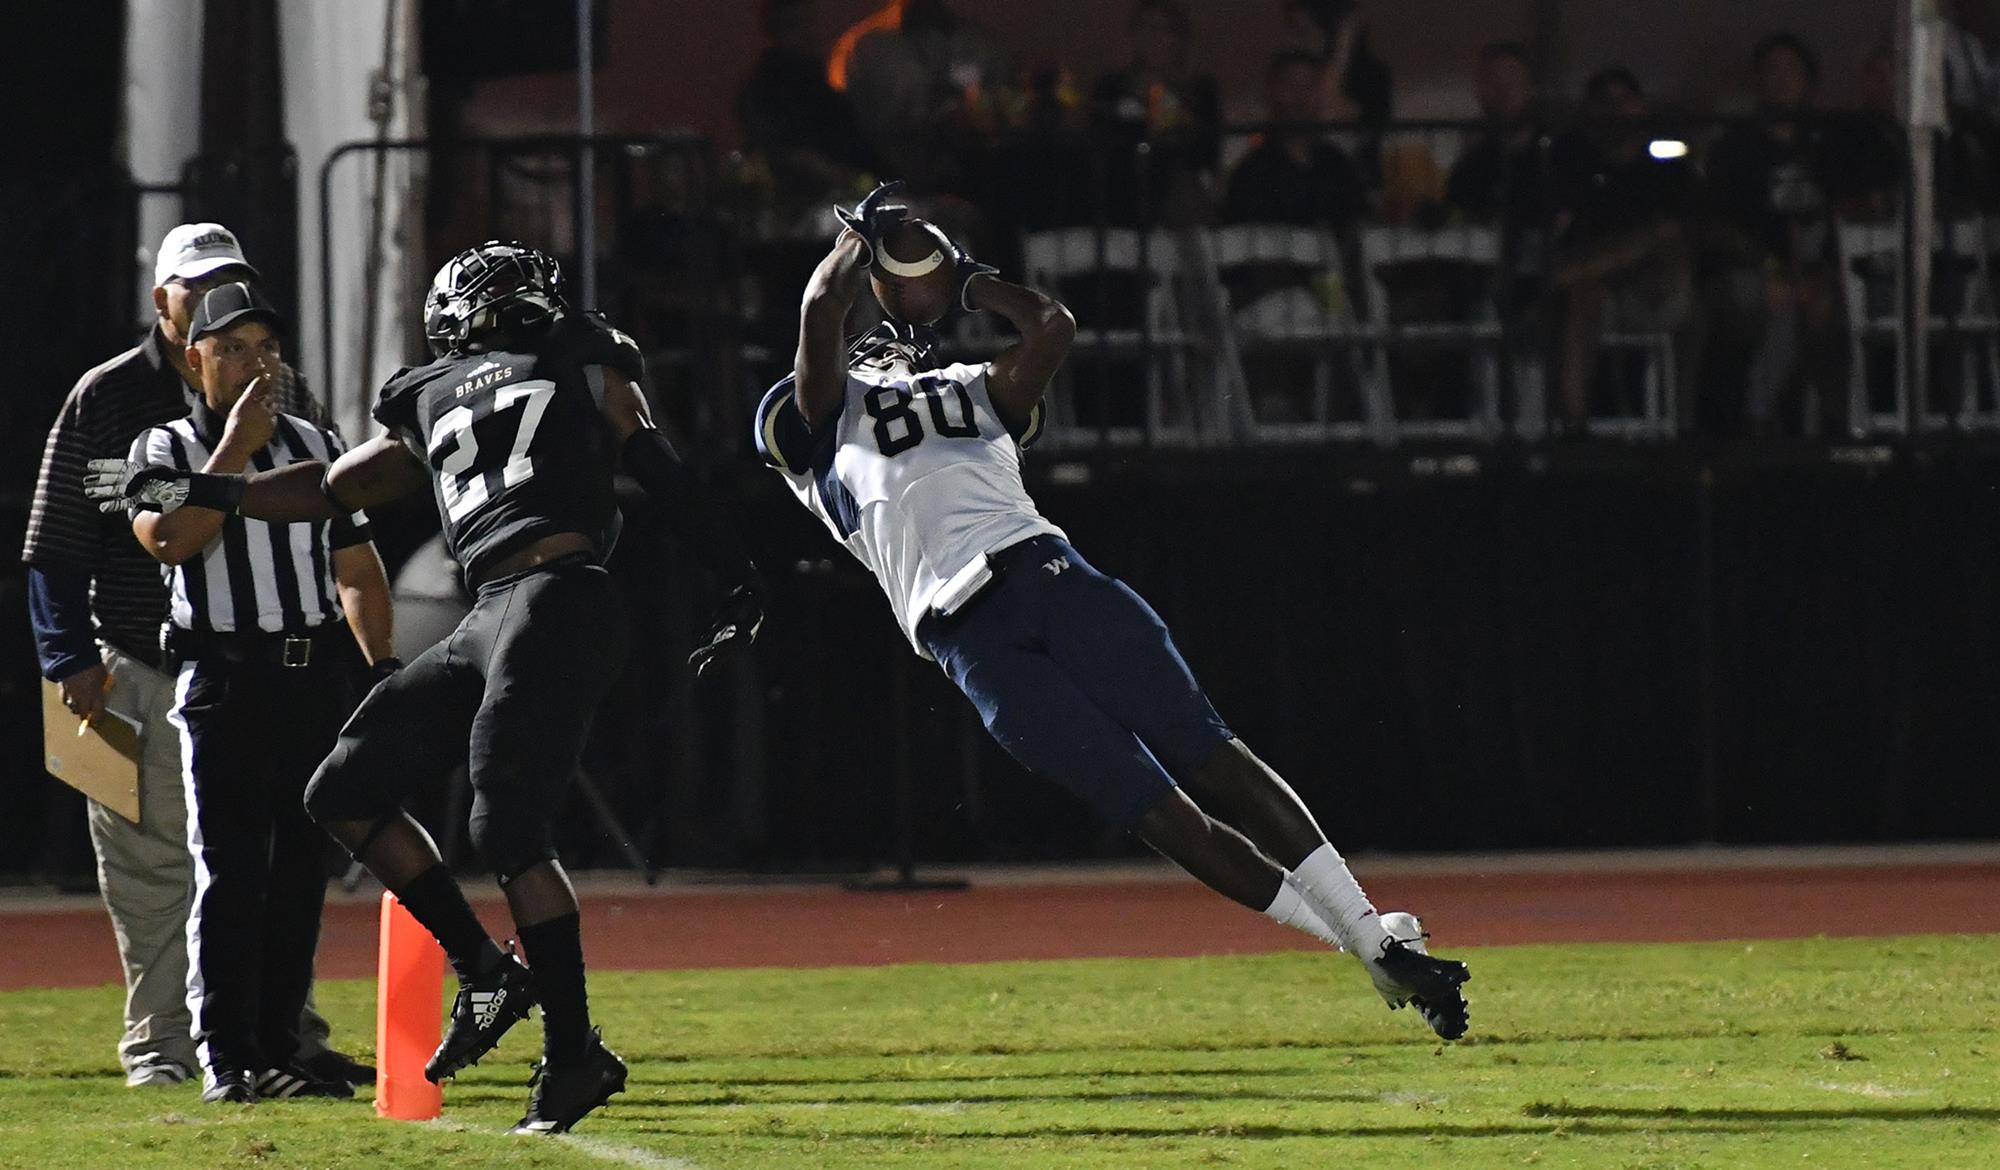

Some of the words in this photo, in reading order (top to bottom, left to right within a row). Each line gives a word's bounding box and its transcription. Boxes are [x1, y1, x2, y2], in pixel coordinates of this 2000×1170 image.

[455, 366, 512, 398] BRAVES
[863, 377, 981, 457] 80
[427, 379, 556, 523] 27
